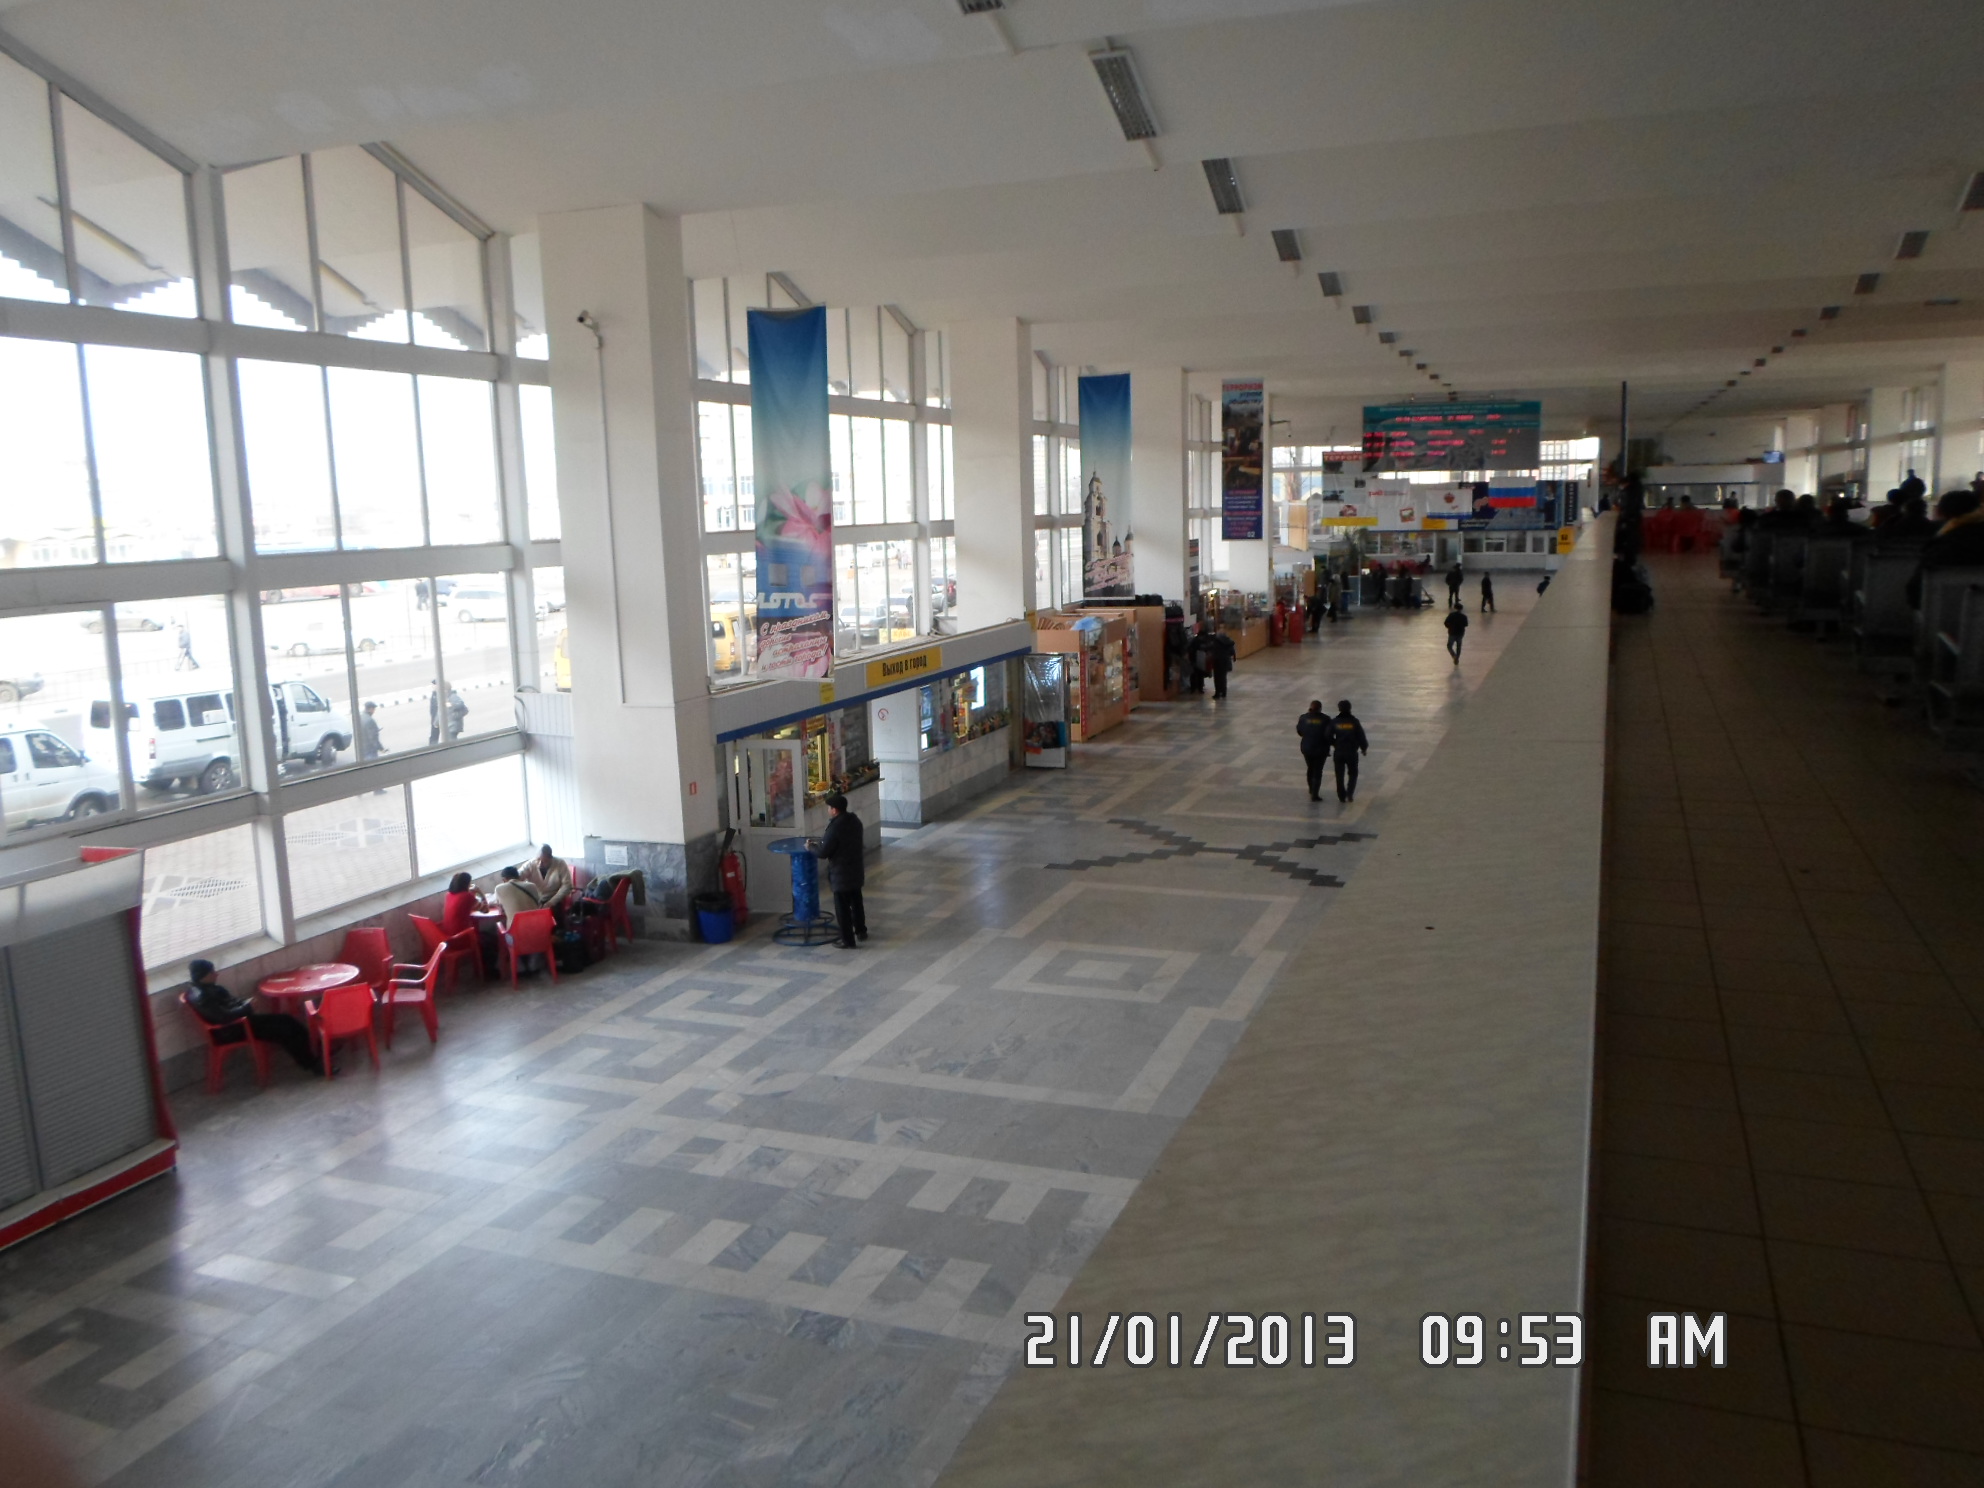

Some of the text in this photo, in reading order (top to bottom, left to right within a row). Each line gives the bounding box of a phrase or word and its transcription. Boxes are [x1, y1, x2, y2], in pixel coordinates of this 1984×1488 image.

[882, 655, 927, 677] Выход в город
